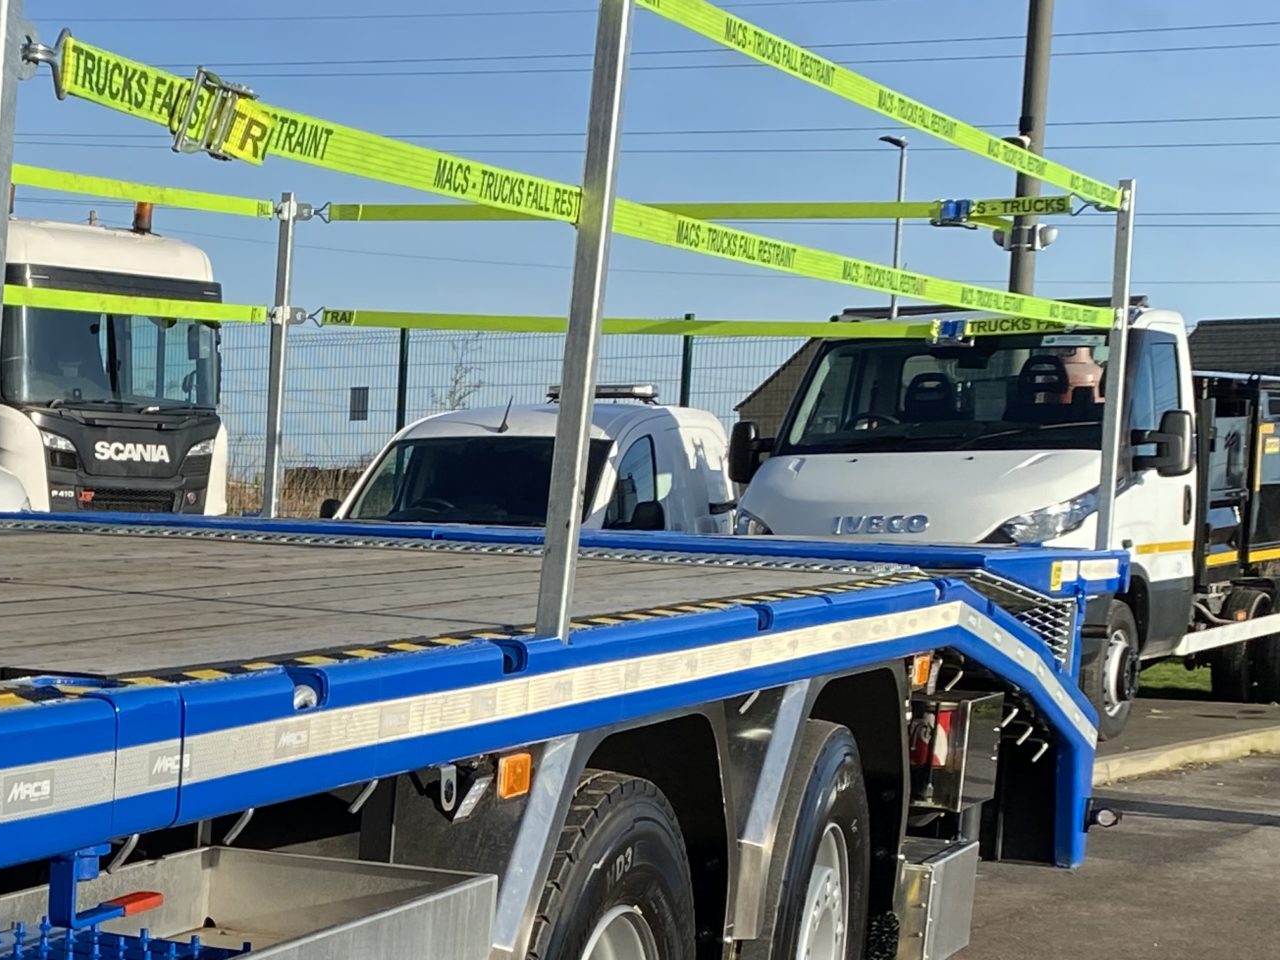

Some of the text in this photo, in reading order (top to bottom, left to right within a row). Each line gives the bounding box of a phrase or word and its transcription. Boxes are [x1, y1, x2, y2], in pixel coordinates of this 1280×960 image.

[725, 17, 749, 49] MACS
[752, 30, 782, 65] TRUCKS
[782, 44, 799, 73] FALL
[71, 45, 149, 110] TRUCKS
[433, 158, 471, 195] MACS
[479, 169, 525, 207] TRUCKS
[525, 181, 550, 213] FALL
[552, 191, 582, 219] REST
[1002, 199, 1066, 214] TRUCKS
[970, 319, 1032, 333] TRUCKS
[94, 440, 171, 463] SCANIA
[831, 513, 931, 535] IVECO
[8, 780, 52, 803] MACS
